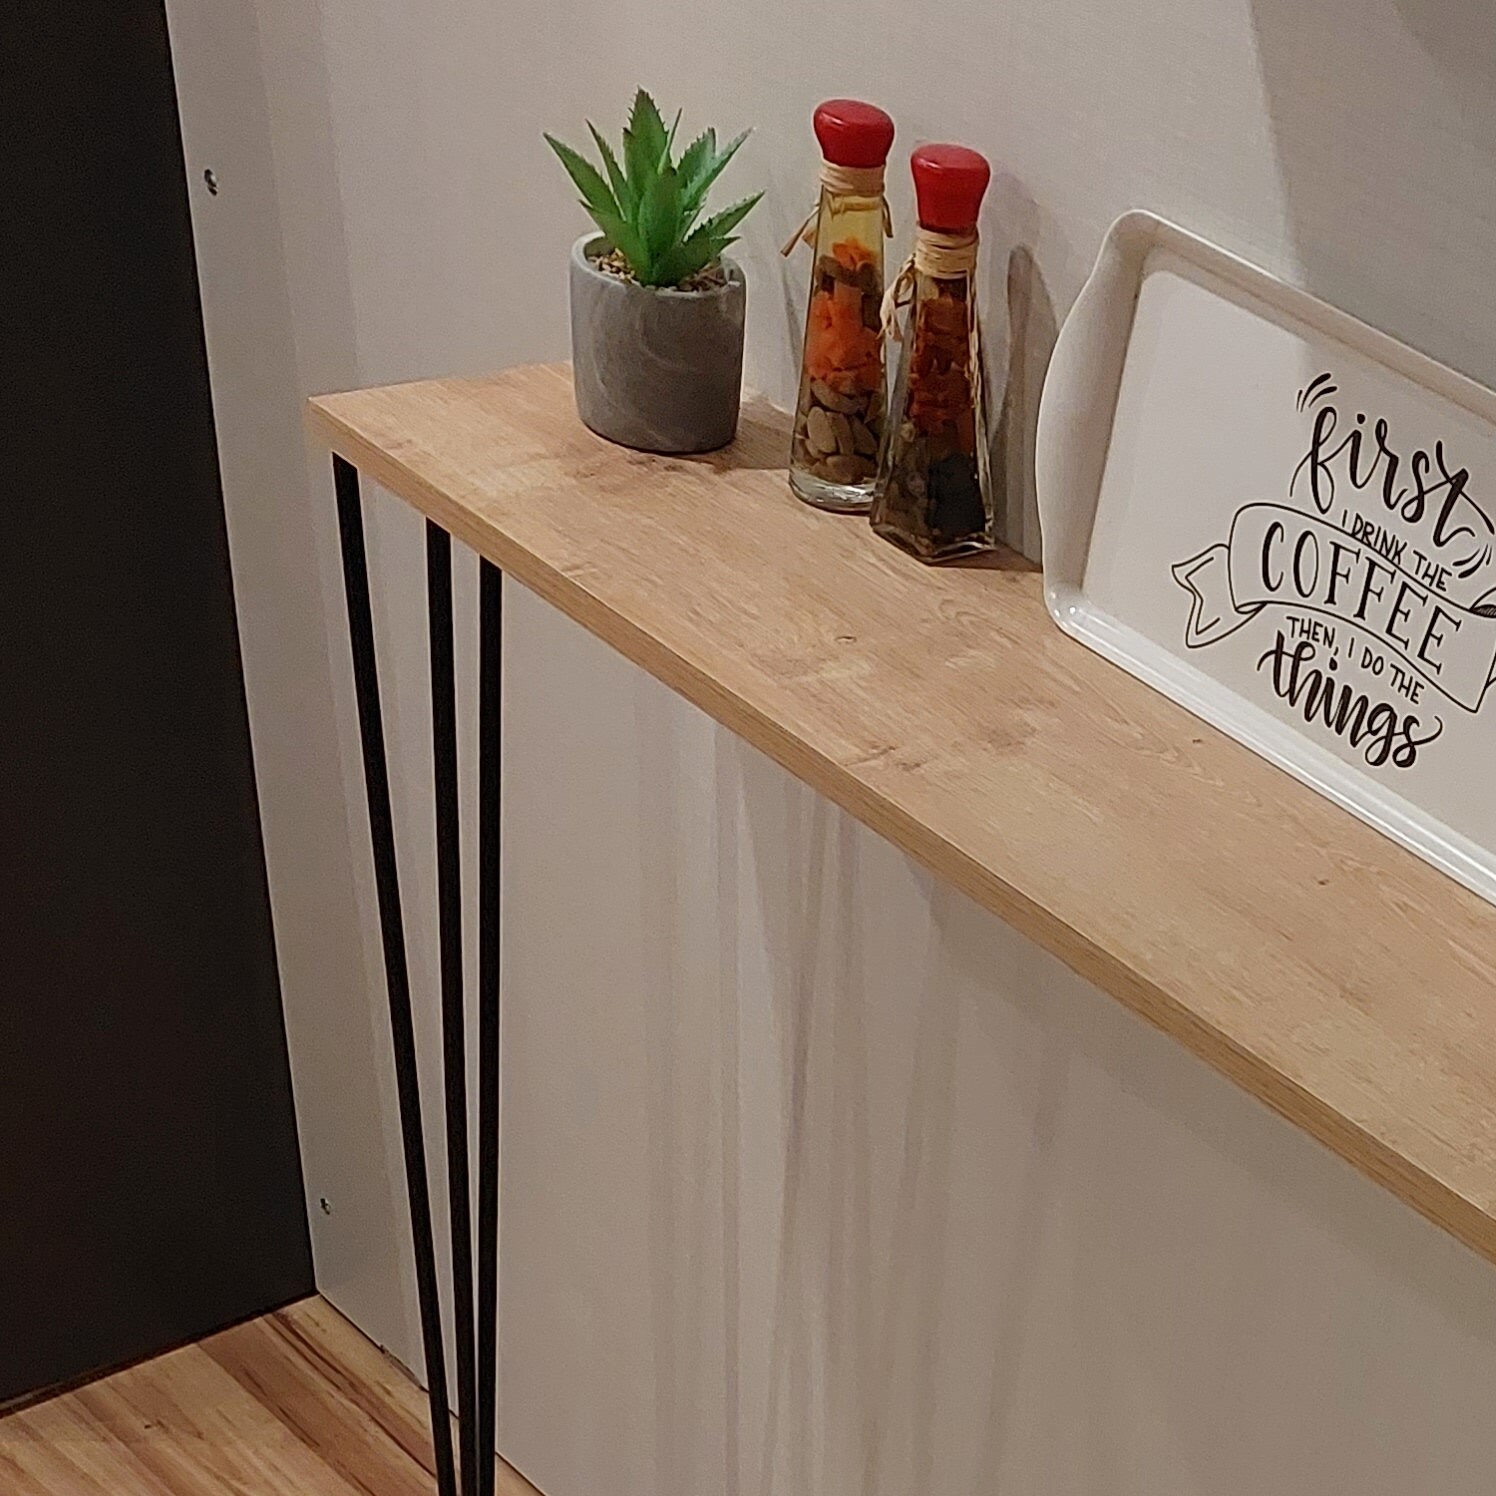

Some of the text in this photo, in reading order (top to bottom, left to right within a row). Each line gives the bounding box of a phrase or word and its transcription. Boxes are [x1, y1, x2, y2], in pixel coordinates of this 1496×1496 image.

[1290, 406, 1495, 547] first
[1261, 521, 1462, 675] COFFEE
[1341, 508, 1453, 592] I DRINK THE
[1257, 630, 1443, 768] things
[1286, 616, 1425, 705] THEN, I DO THE
